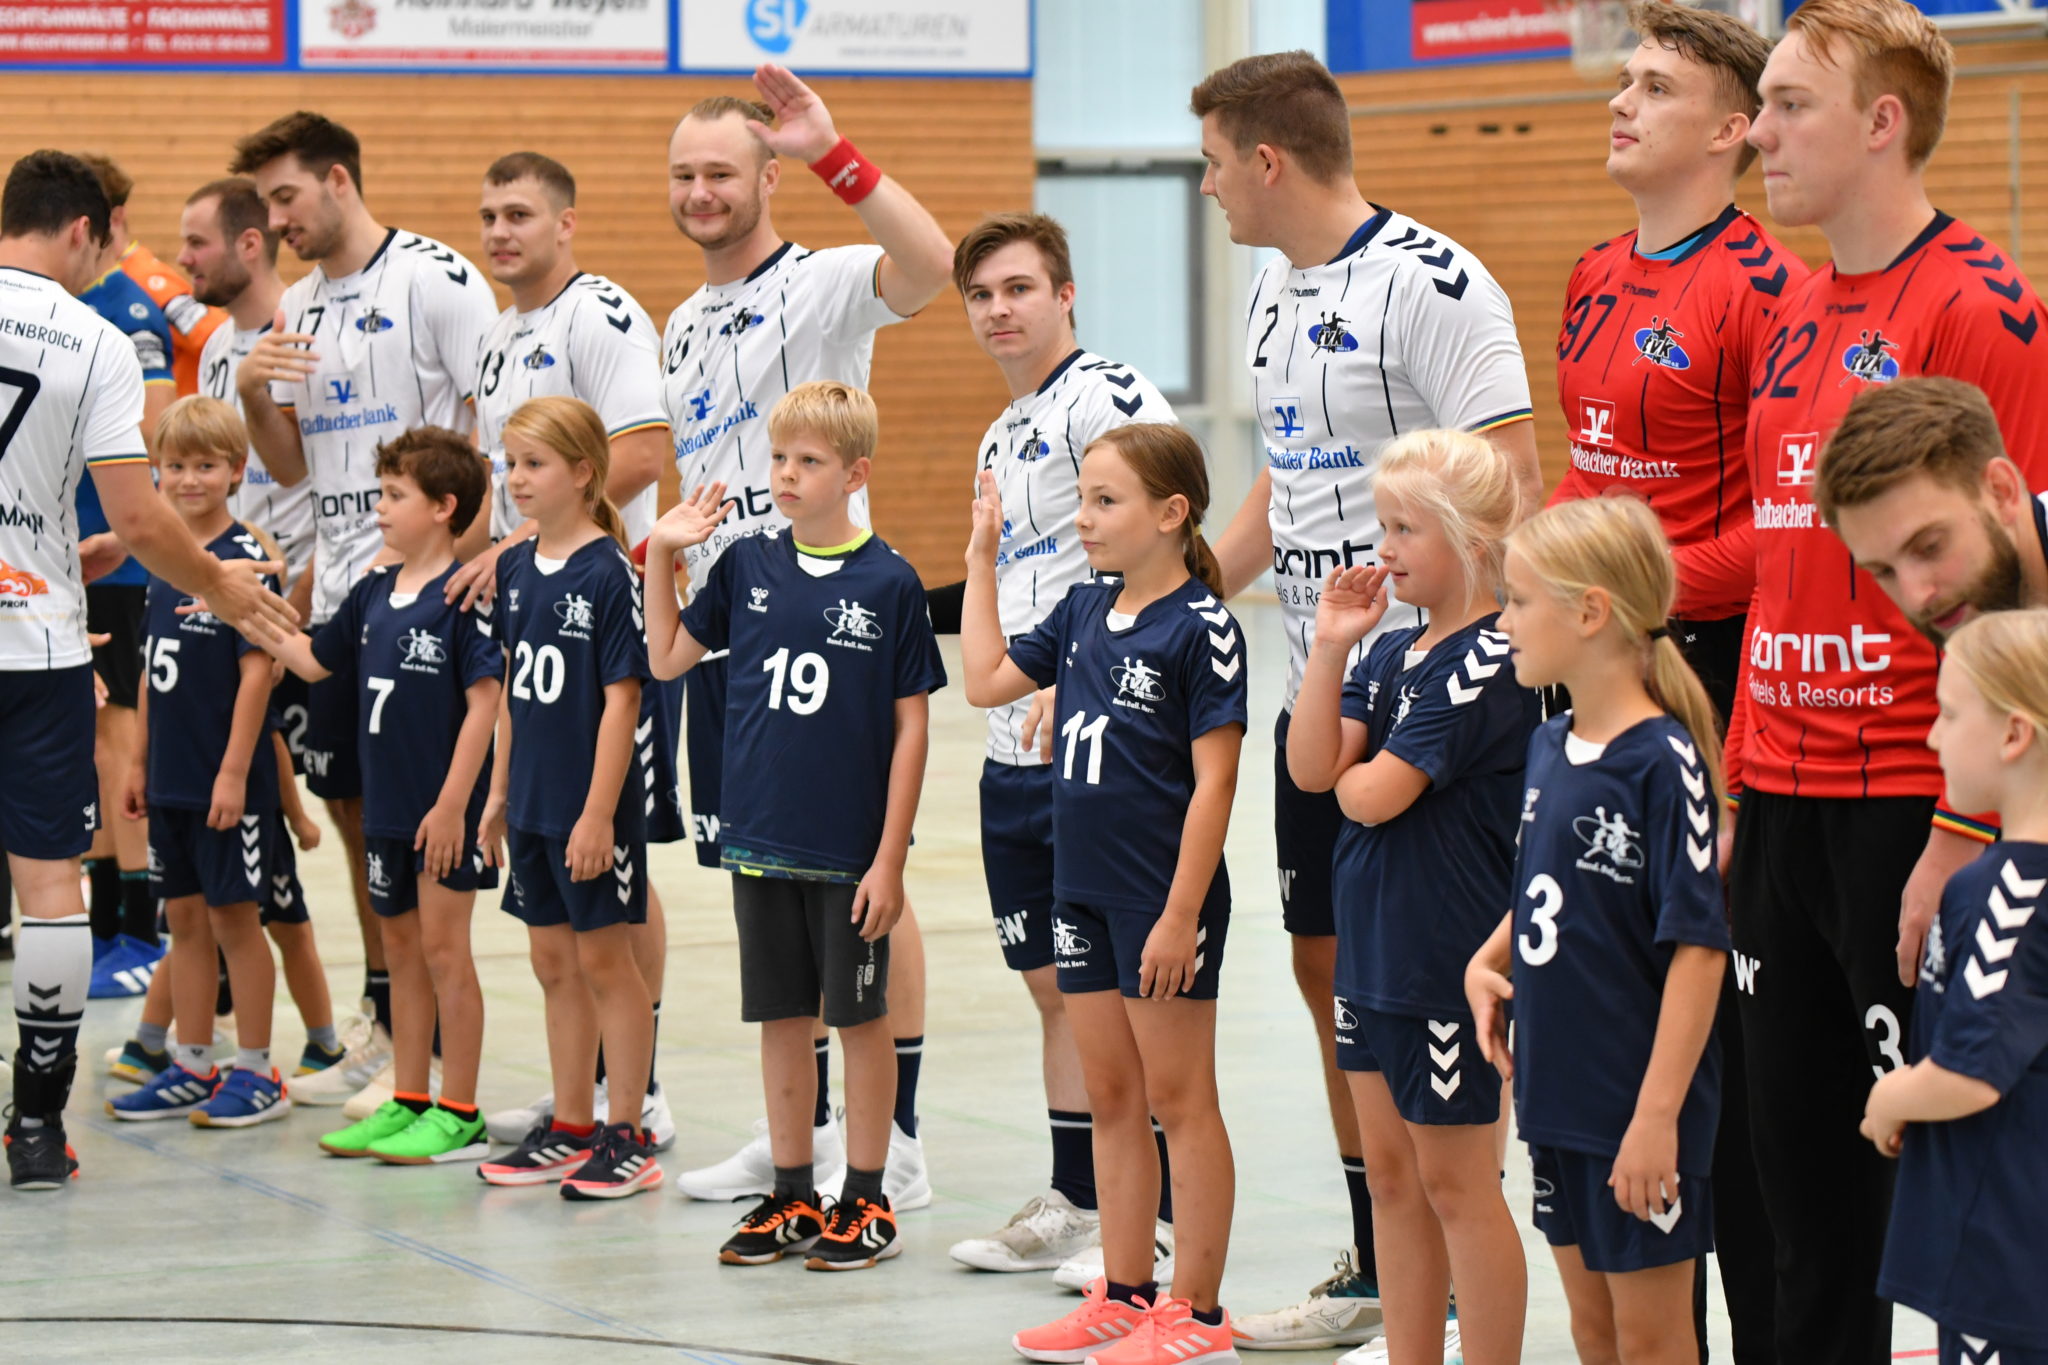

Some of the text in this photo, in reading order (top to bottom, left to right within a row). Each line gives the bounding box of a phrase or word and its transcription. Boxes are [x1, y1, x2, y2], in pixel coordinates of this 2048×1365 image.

[808, 12, 968, 40] ARMATUREN
[1252, 303, 1279, 368] 2
[1315, 325, 1350, 347] tvk
[1559, 293, 1618, 363] 97
[1752, 319, 1819, 399] 32
[1309, 445, 1365, 470] Bank
[1620, 455, 1681, 479] Bank
[1292, 585, 1301, 606] &
[144, 634, 181, 694] 15
[512, 640, 565, 704] 20
[763, 646, 830, 716] 19
[1120, 671, 1156, 694] tvk
[367, 676, 395, 735] 7
[1780, 681, 1792, 706] &
[1798, 681, 1894, 707] Resorts
[1061, 710, 1110, 786] 11
[1517, 873, 1564, 967] 3
